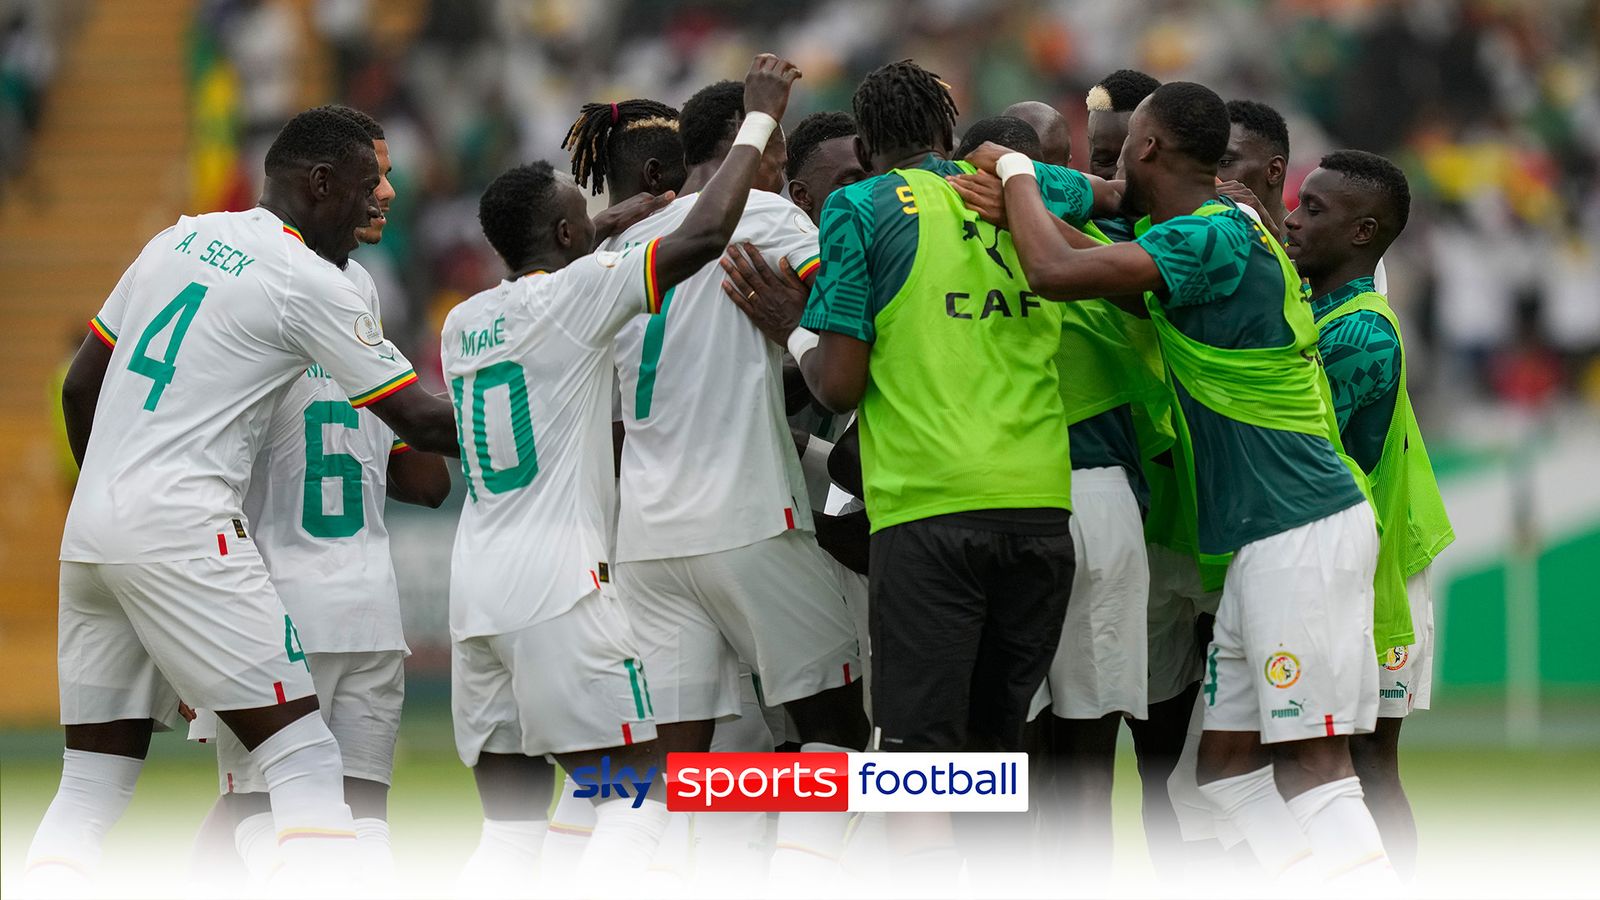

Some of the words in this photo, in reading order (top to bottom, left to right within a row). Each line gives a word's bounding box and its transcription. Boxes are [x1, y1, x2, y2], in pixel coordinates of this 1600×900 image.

[175, 231, 198, 255] A.
[199, 239, 255, 277] SECK
[945, 289, 1041, 320] CAF
[127, 281, 209, 412] 4
[461, 312, 506, 357] MANÉ
[452, 359, 539, 503] 10
[302, 400, 366, 538] 6
[284, 613, 311, 674] 4
[1271, 708, 1300, 719] PUMA
[1379, 689, 1405, 699] PUMA
